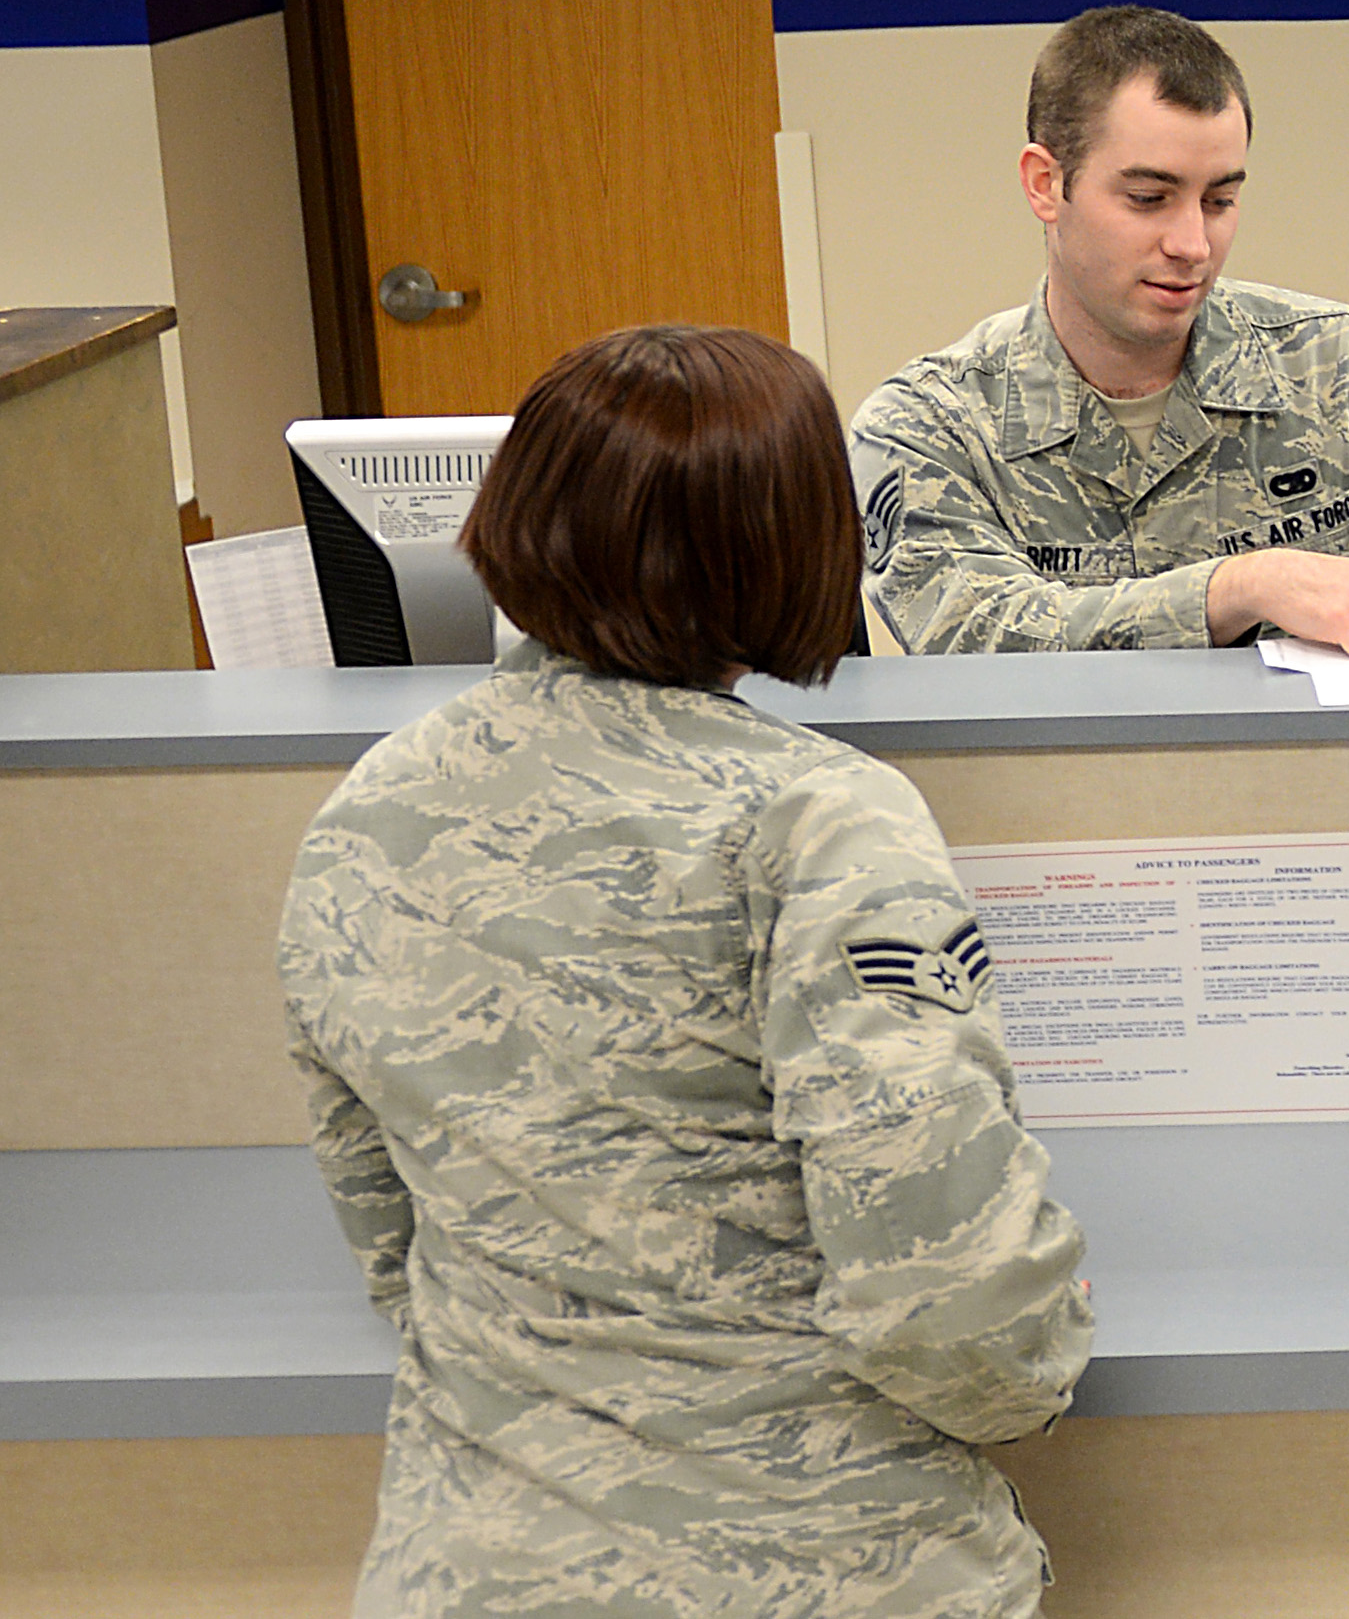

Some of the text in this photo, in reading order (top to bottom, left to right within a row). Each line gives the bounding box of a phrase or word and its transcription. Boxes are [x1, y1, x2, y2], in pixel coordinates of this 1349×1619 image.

[1270, 517, 1304, 545] AIR
[1135, 860, 1173, 869] ADVICE
[1194, 857, 1260, 867] PASSENGERS
